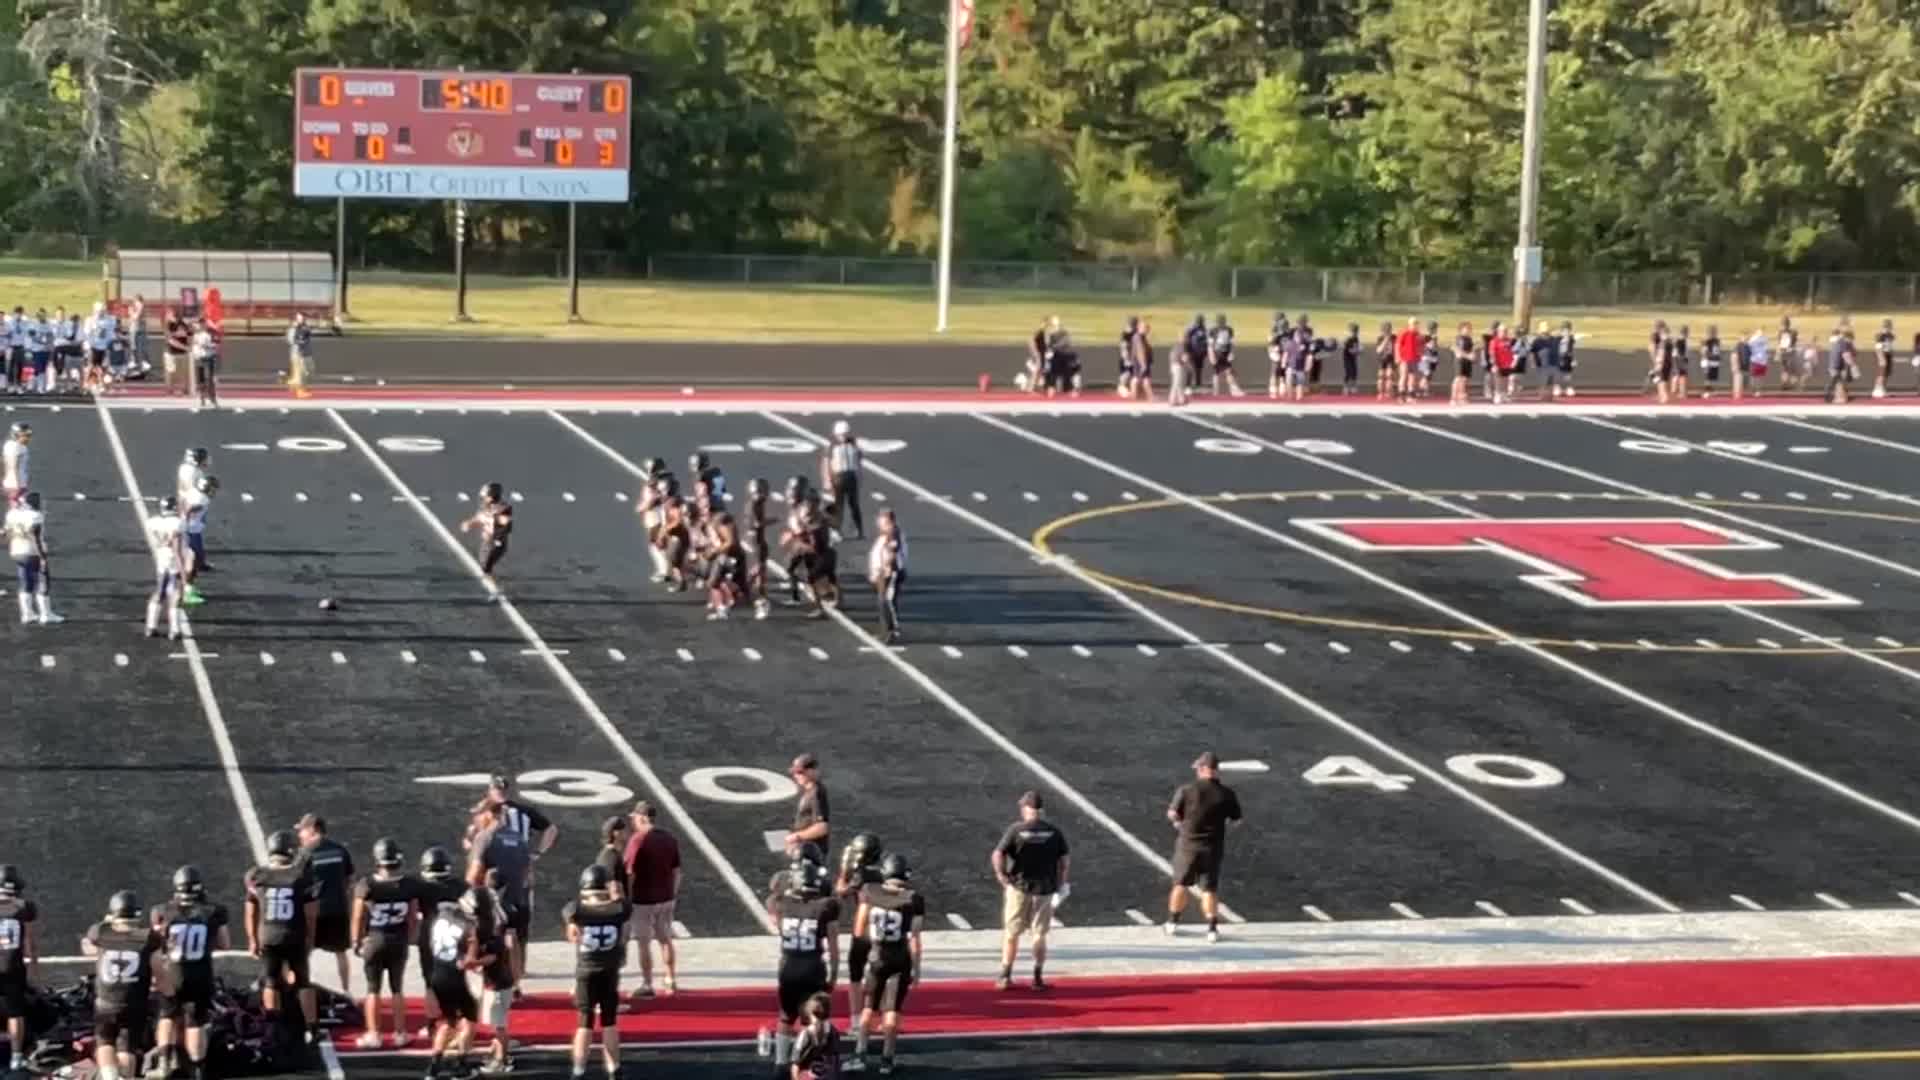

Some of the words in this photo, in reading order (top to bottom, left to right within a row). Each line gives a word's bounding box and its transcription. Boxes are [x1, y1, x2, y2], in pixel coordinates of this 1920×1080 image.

[320, 75, 341, 106] 0
[441, 79, 509, 110] 5:40
[604, 82, 625, 112] 0
[312, 136, 331, 159] 4
[367, 135, 385, 161] 0
[556, 139, 574, 165] 0
[599, 141, 614, 166] 3
